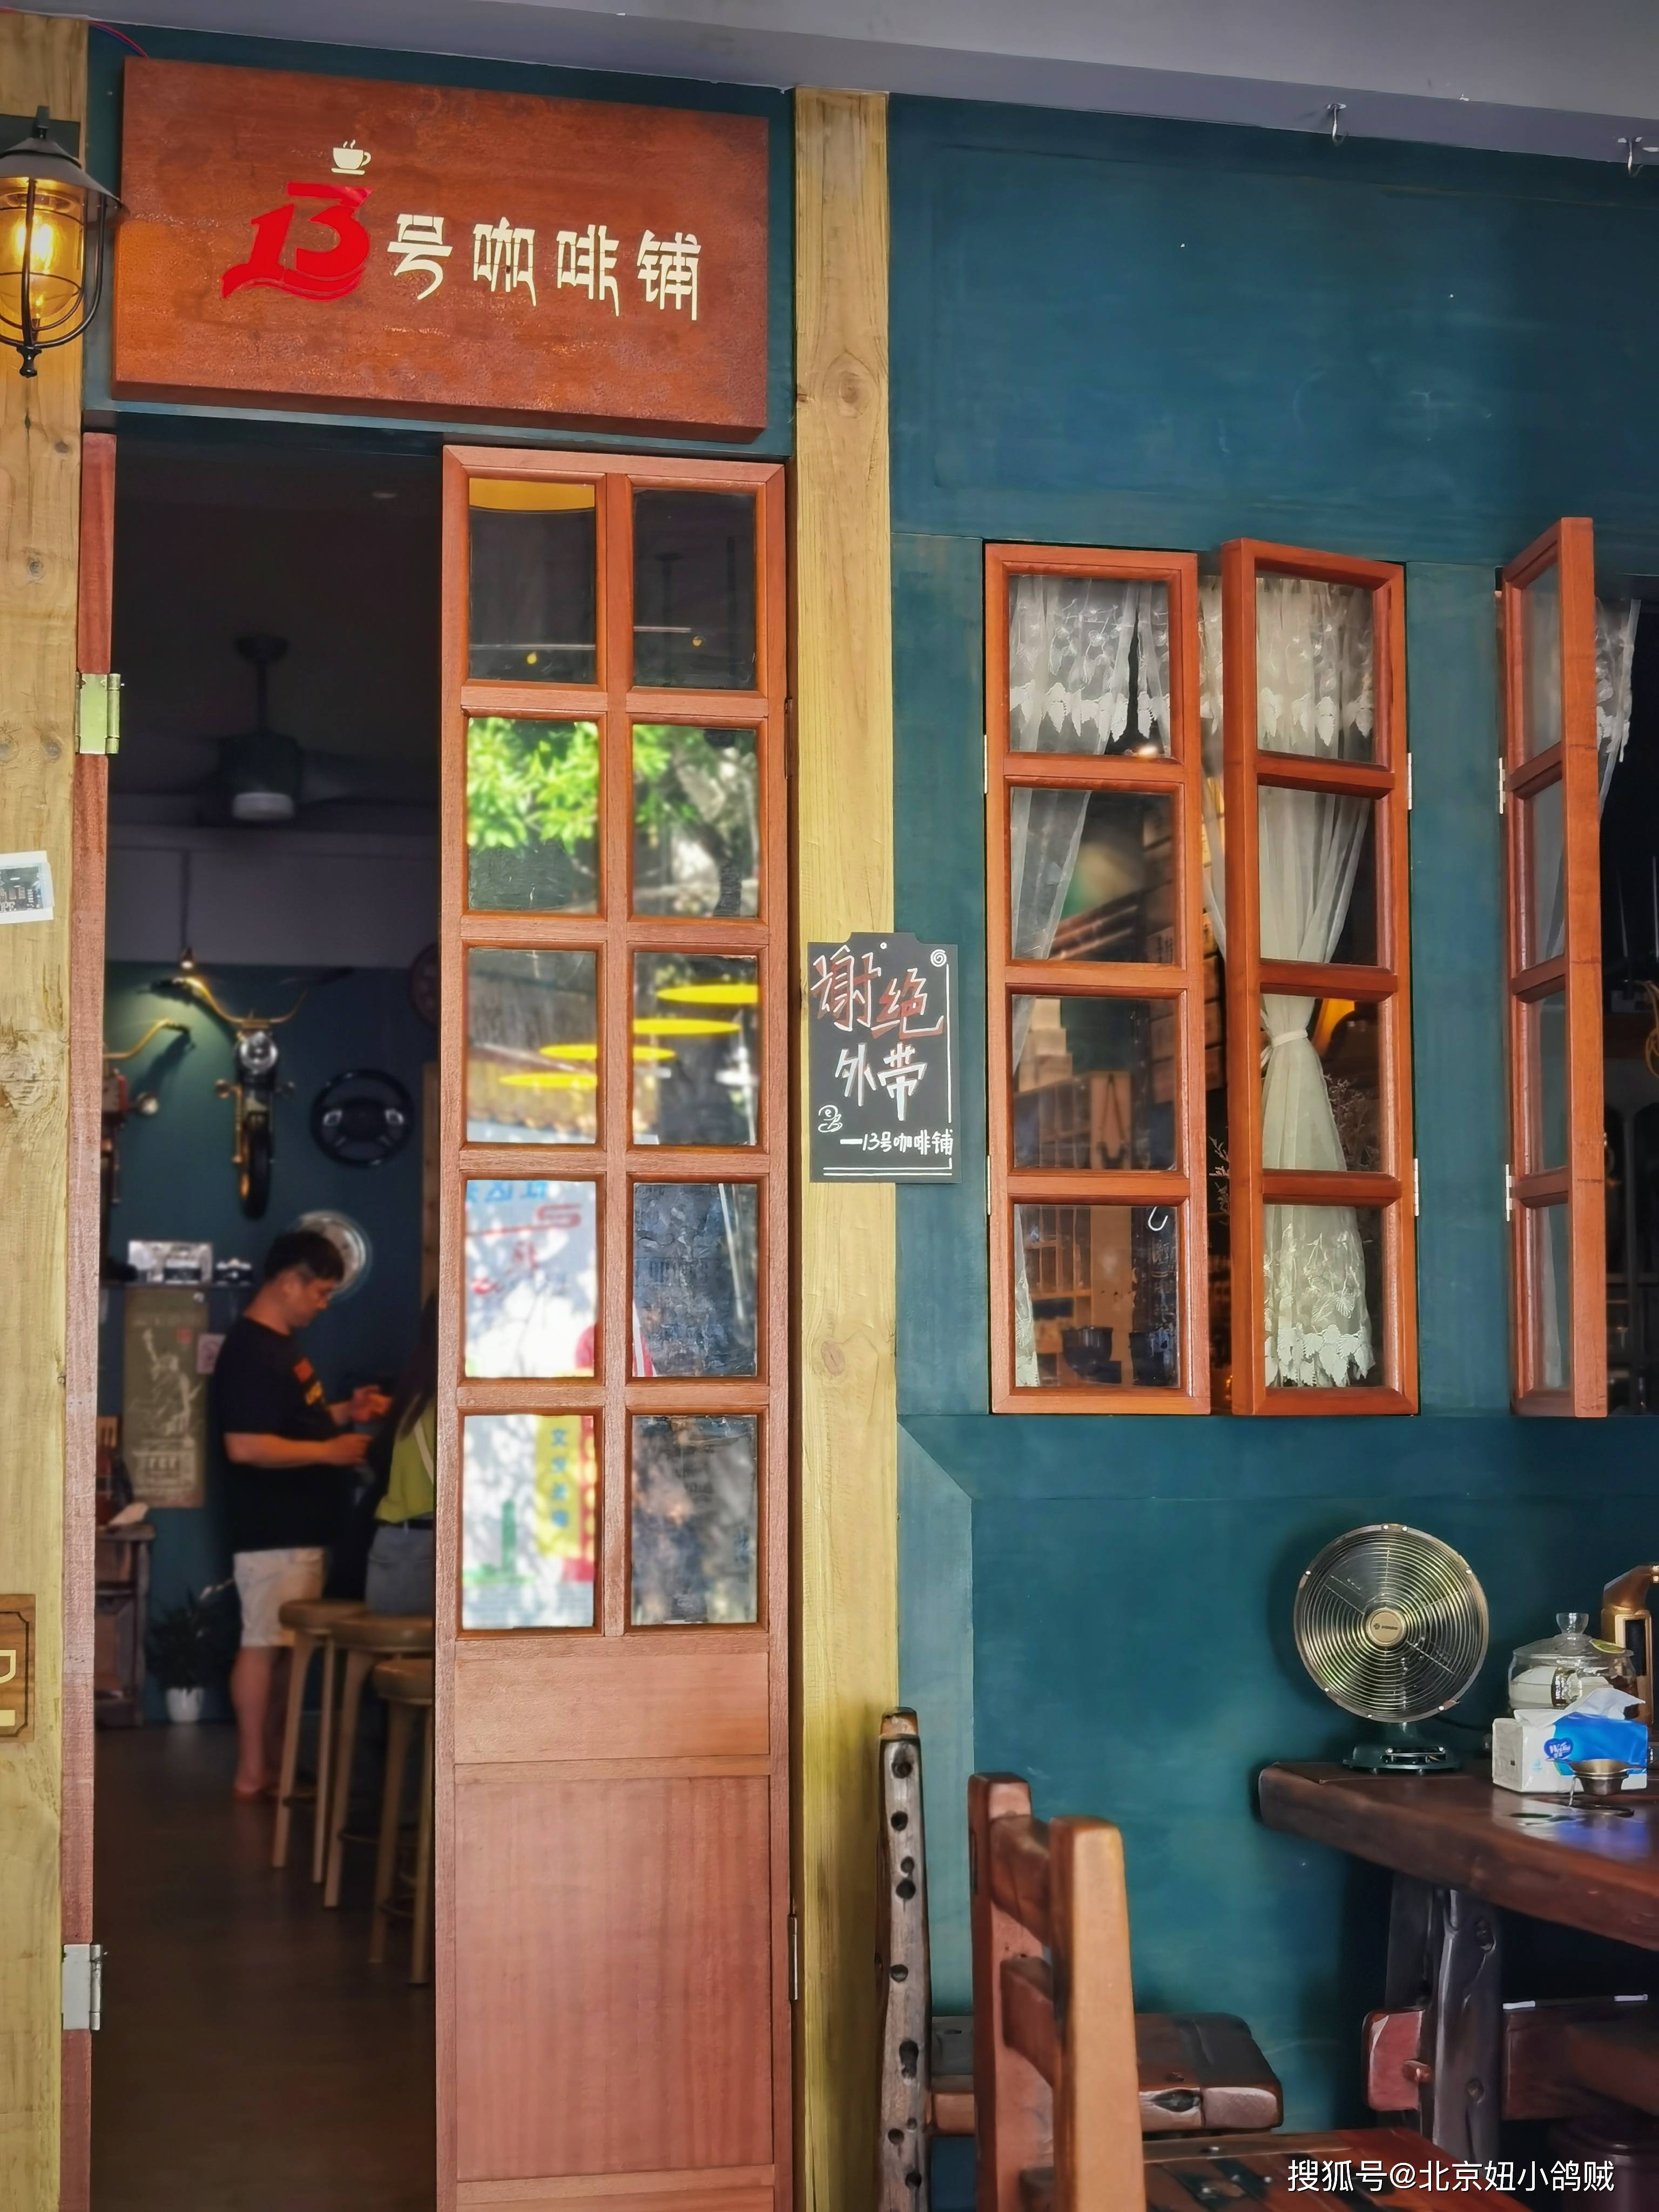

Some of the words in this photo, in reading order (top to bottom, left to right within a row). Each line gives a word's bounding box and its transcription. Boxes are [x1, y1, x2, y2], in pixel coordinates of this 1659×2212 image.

[221, 181, 701, 321] 13号咖啡铺
[811, 945, 945, 1040] 谢绝
[835, 1042, 928, 1121] 外带
